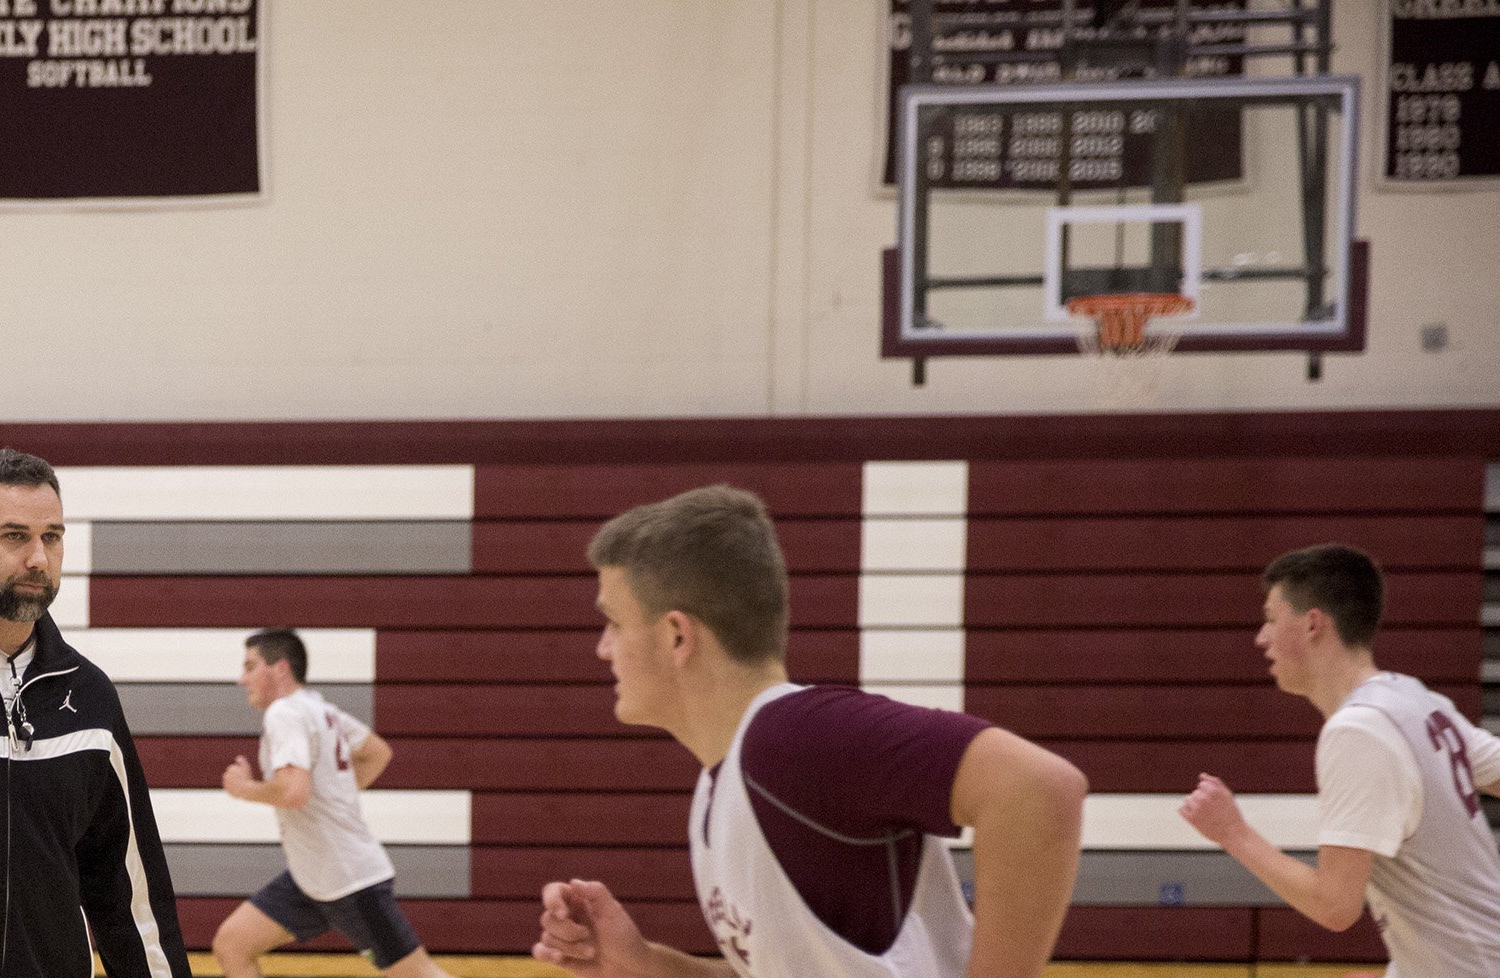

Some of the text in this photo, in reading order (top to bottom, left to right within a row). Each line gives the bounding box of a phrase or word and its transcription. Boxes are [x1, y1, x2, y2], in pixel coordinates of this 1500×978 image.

[48, 17, 129, 56] HIGH
[130, 16, 257, 55] SCHOOL
[26, 58, 152, 88] SOFTBALL
